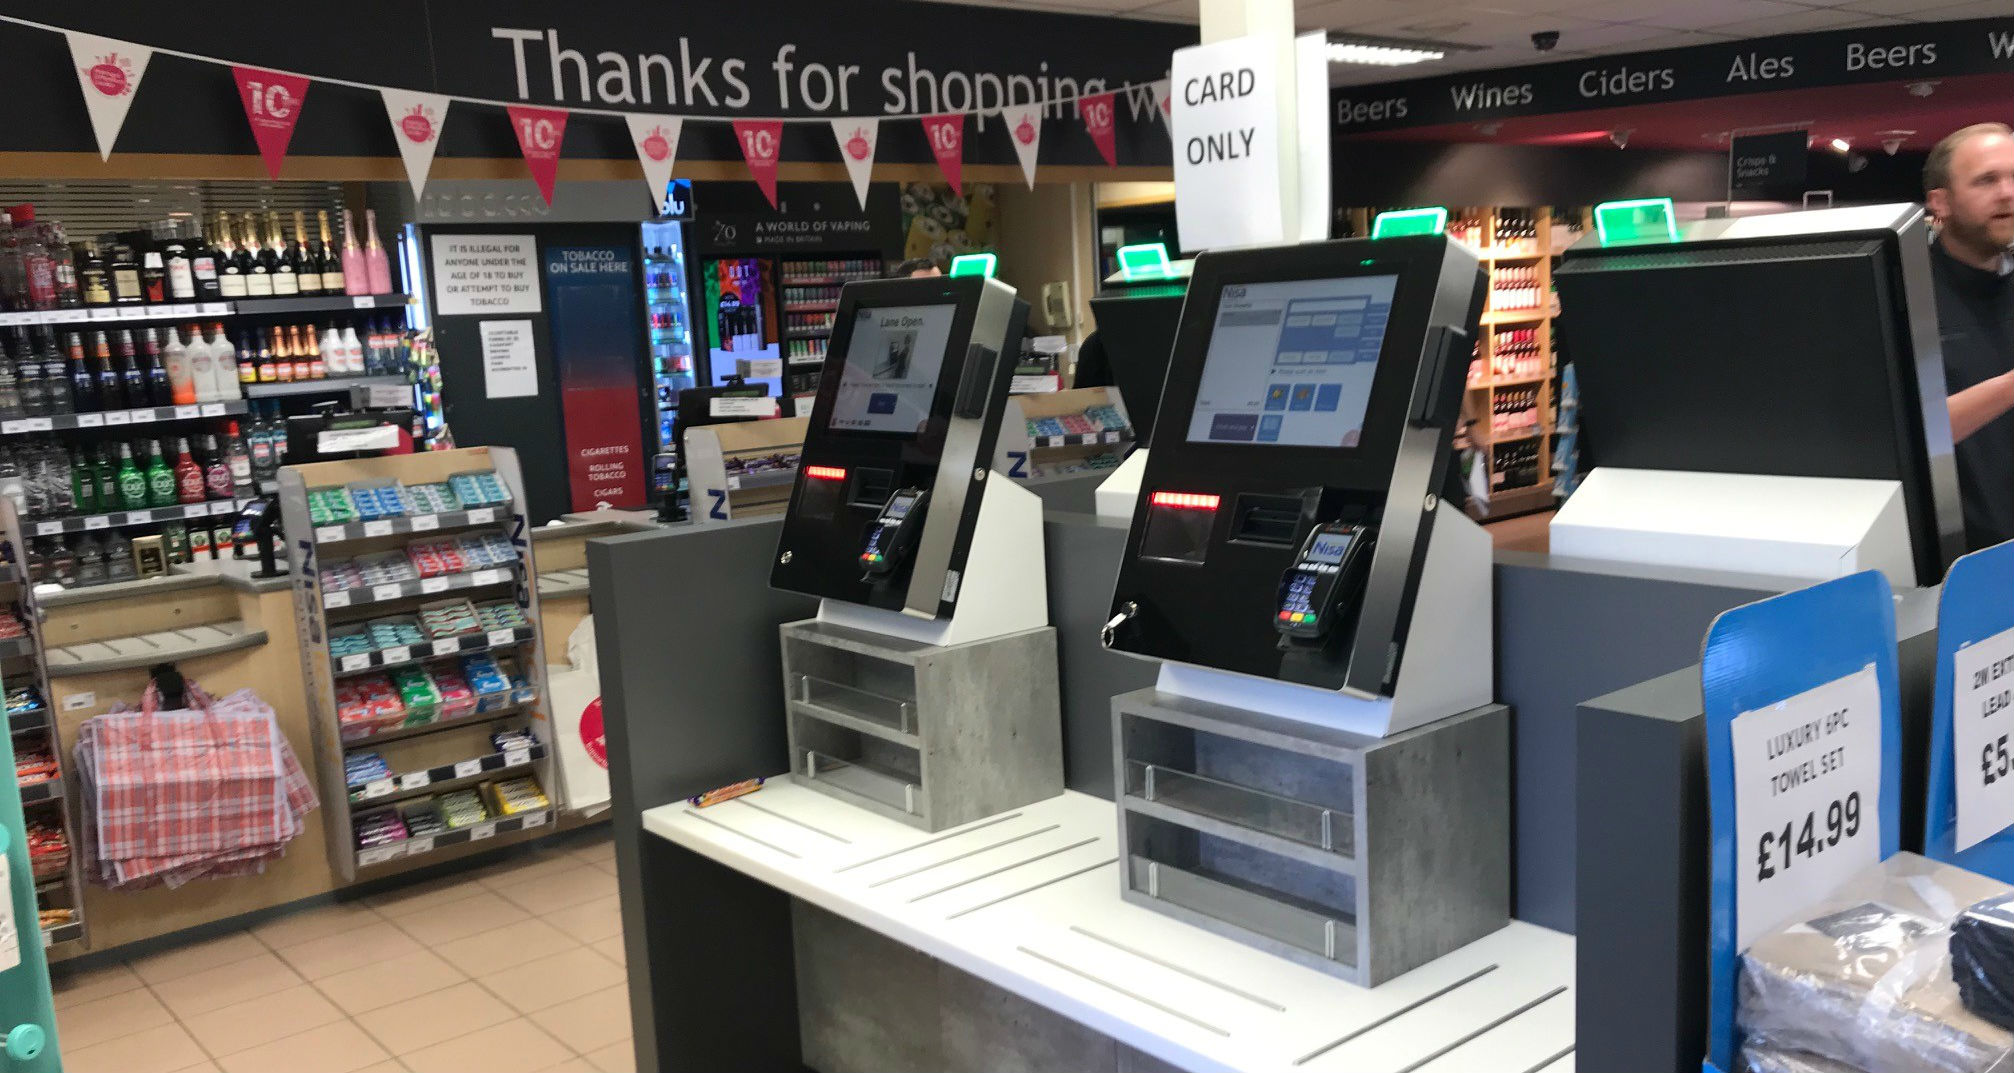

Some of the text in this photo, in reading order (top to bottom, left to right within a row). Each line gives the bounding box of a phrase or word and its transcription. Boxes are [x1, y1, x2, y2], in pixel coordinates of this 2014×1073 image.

[1726, 52, 1795, 83] Ales
[1846, 42, 1938, 72] Beers
[491, 27, 751, 109] Thanks
[772, 43, 861, 112] for
[1185, 67, 1256, 107] CARD
[1578, 67, 1675, 99] Ciders
[1451, 82, 1533, 111] Wines
[1337, 98, 1408, 125] Beers
[1187, 127, 1256, 166] ONLY
[766, 221, 809, 232] WORLD
[812, 221, 828, 231] OF
[829, 220, 871, 231] VAPING
[469, 245, 501, 253] ILLEGAL
[562, 251, 614, 261] TOBACCO
[445, 258, 527, 266] ANYONE UNDER THE
[550, 261, 628, 274] ON SALE HERE
[461, 285, 498, 293] ATTEMPT
[581, 446, 630, 457] CIGARETTES
[588, 471, 626, 481] TOBACCO
[589, 462, 624, 472] ROLLING
[594, 487, 624, 497] CIGARS
[1312, 541, 1345, 557] Nisa
[1767, 718, 1822, 760] LUXURY
[1771, 746, 1844, 797] TOWEL SET
[1757, 790, 1861, 882] £14.99
